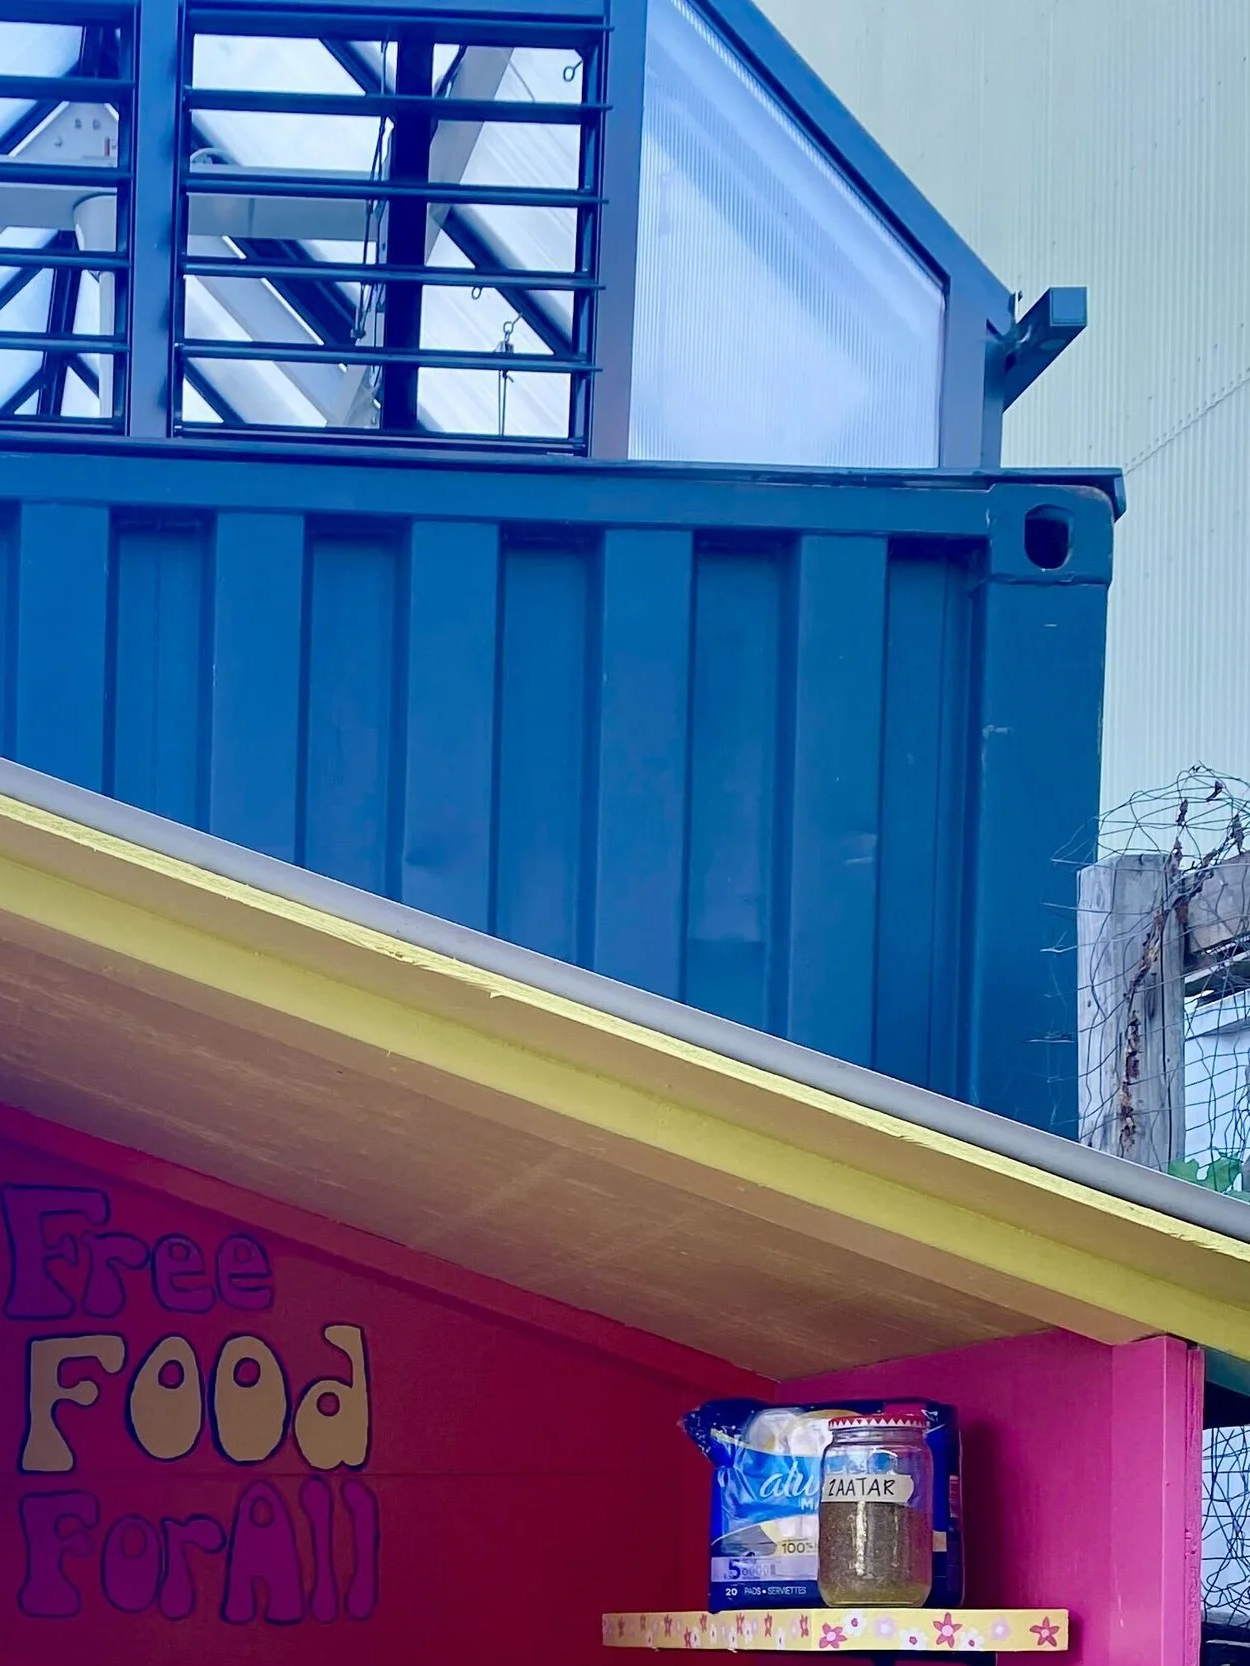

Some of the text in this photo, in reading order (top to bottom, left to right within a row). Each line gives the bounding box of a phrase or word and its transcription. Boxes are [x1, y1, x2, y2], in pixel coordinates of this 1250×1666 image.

[0, 1182, 274, 1321] Free
[760, 1461, 819, 1497] alw
[828, 1478, 896, 1496] ZAATAR
[726, 1588, 738, 1596] 20
